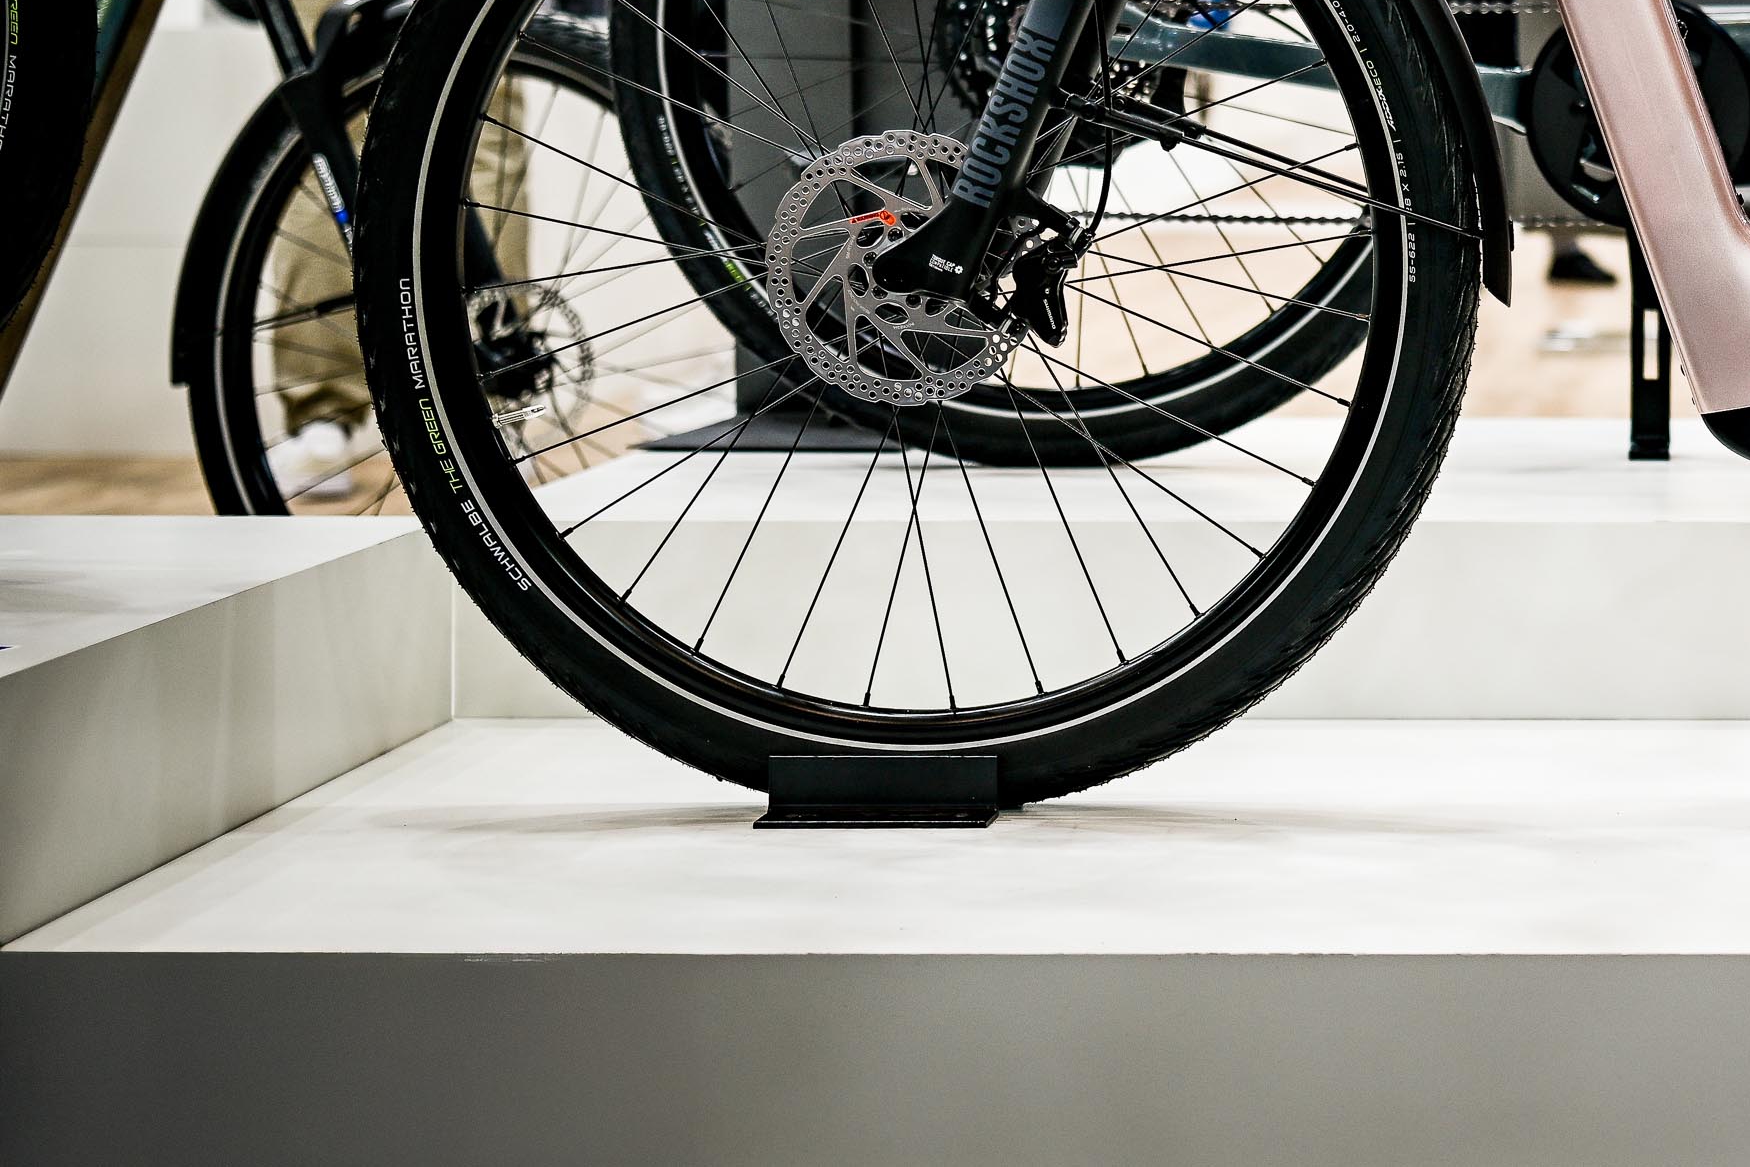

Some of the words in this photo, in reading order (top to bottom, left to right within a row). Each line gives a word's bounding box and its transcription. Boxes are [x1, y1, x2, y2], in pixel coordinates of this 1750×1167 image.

[1332, 0, 1361, 43] 2.0-4.0
[0, 55, 17, 151] MARATH
[953, 30, 1057, 209] ROCKSHOX
[1396, 152, 1408, 178] 2.15
[1408, 233, 1416, 283] 55-622
[399, 278, 426, 389] MARATHON
[418, 398, 447, 455] GREEN
[439, 458, 464, 495] THE
[460, 499, 533, 592] SCHWALBE
